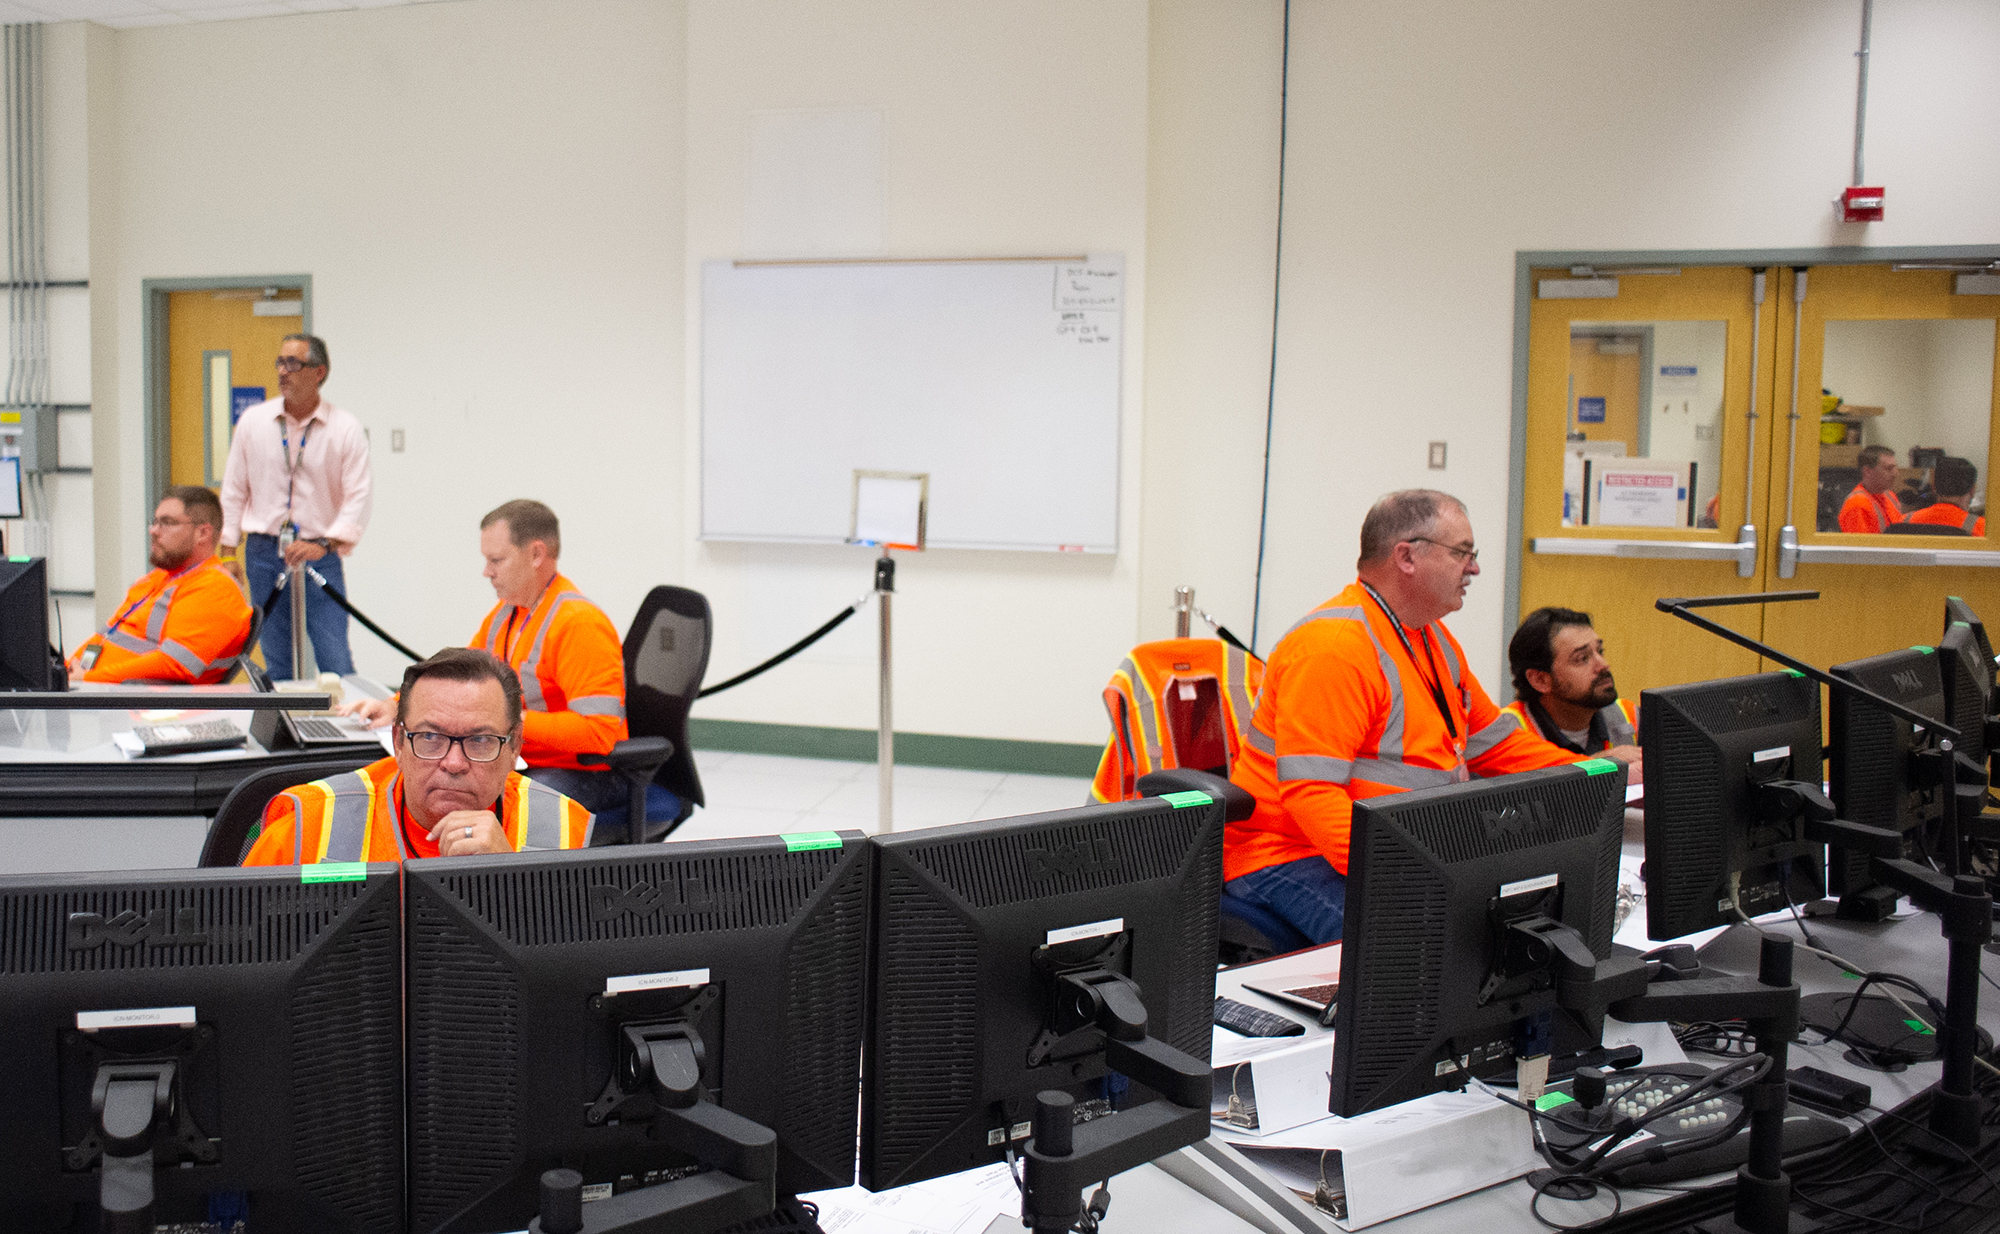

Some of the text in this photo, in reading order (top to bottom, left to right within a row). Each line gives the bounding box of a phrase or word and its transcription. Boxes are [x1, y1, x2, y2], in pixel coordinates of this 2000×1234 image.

[1480, 800, 1553, 840] DELL
[1024, 838, 1121, 883] DELL
[588, 878, 714, 922] DELL
[69, 908, 207, 950] DELL
